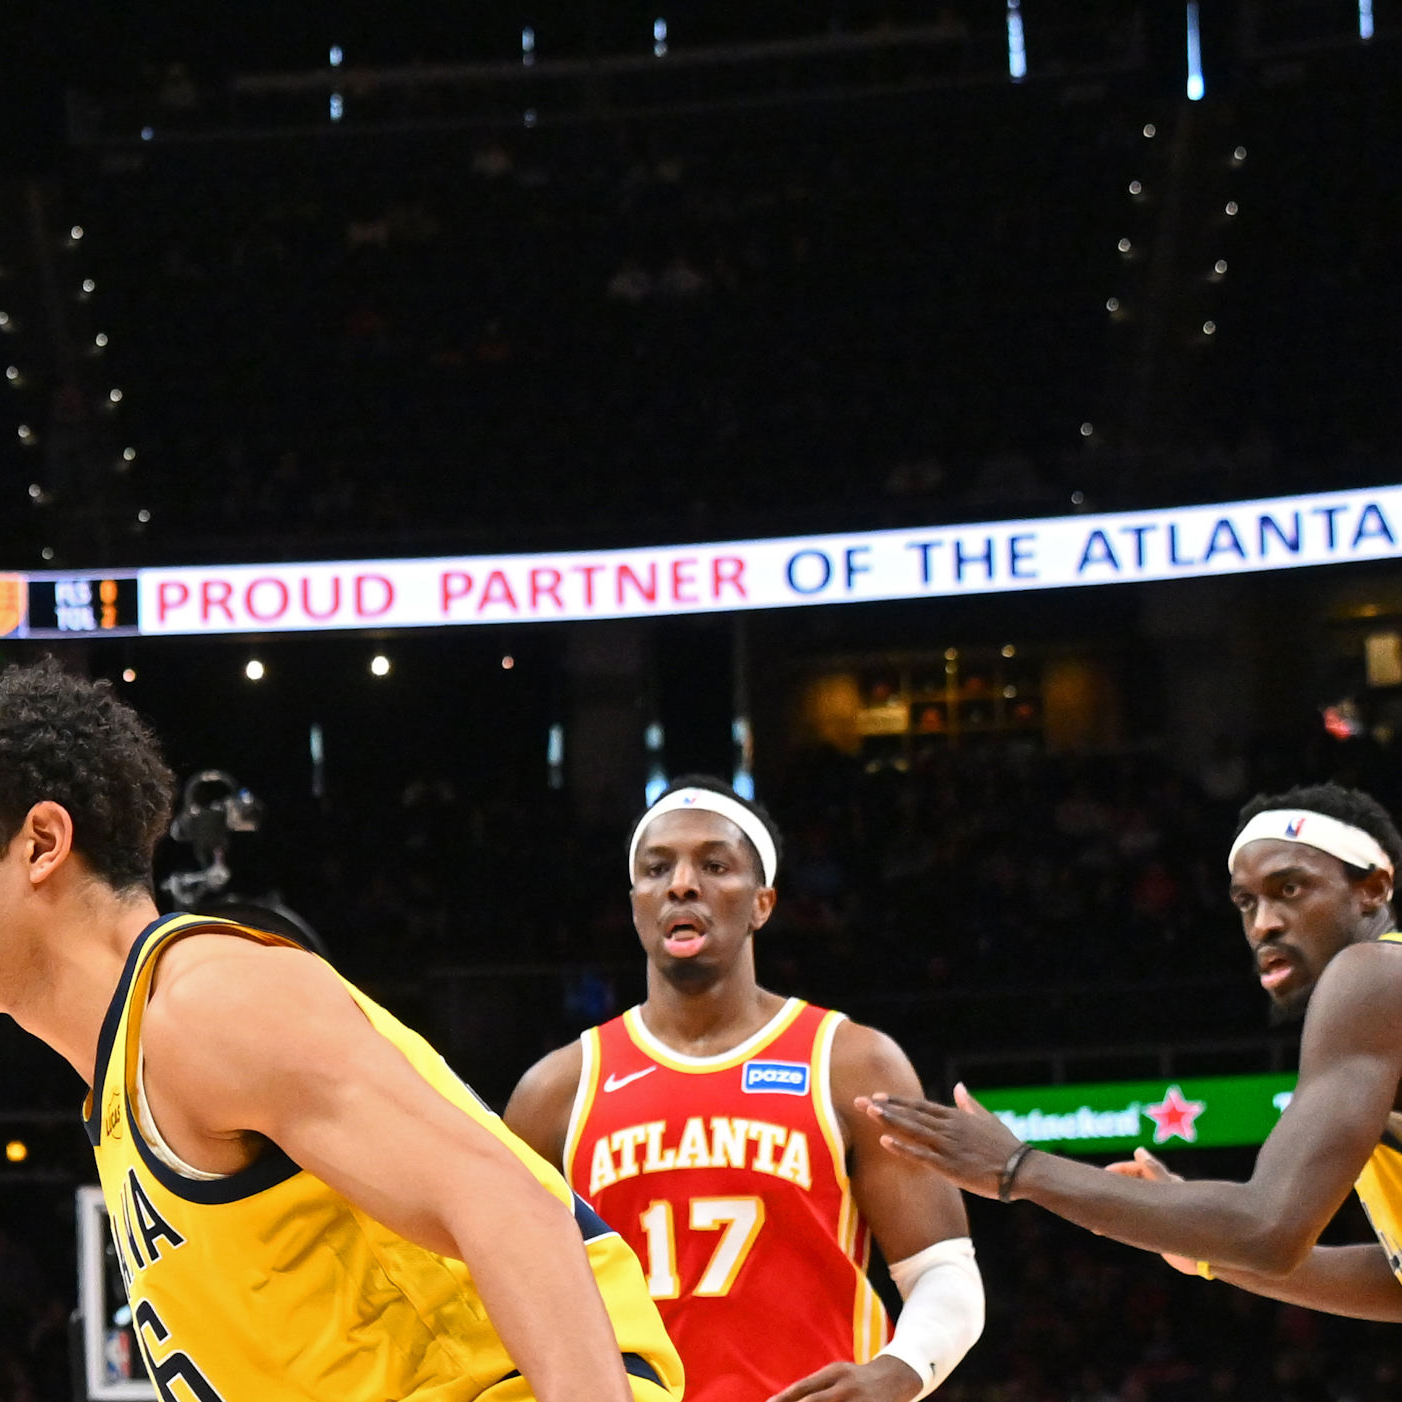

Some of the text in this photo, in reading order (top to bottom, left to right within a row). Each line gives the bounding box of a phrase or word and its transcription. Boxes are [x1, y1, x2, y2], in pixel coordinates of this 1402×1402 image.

[156, 502, 1396, 625] PROUD PARTNER OF THE ATLANTA
[748, 1067, 804, 1086] paze
[589, 1116, 813, 1198] ATLANTA
[639, 1195, 767, 1301] 17
